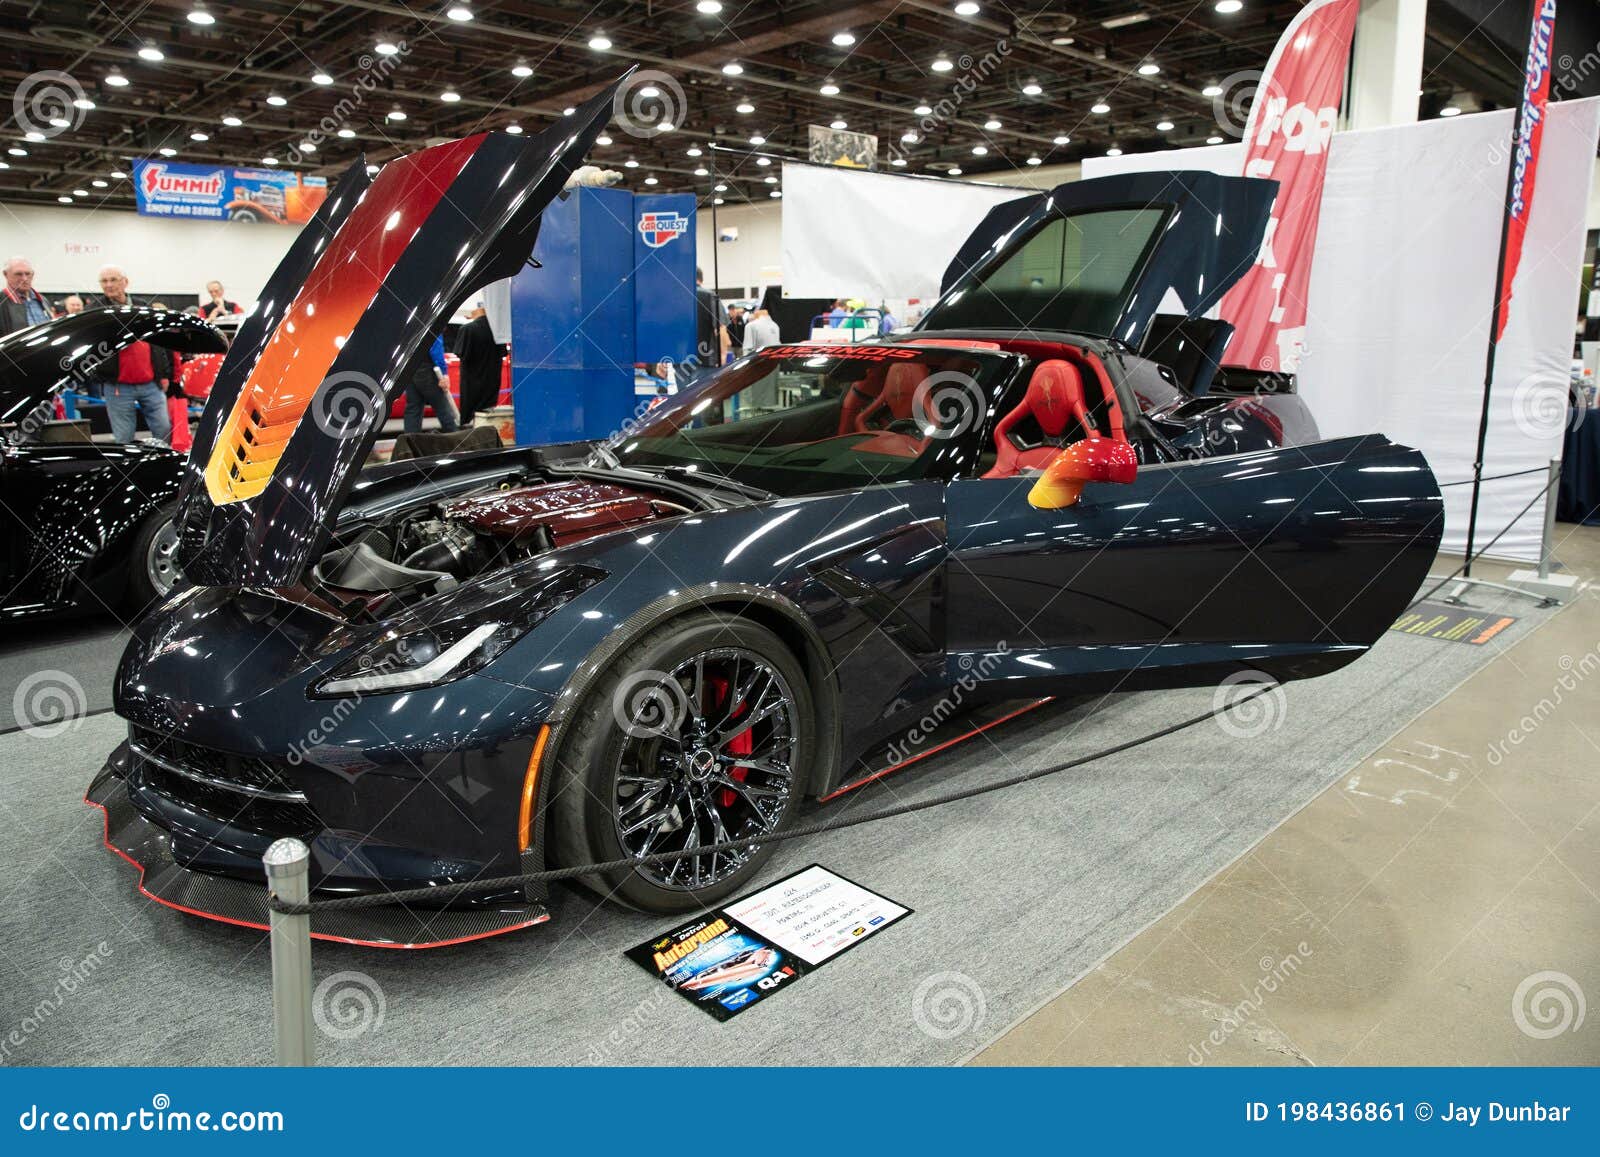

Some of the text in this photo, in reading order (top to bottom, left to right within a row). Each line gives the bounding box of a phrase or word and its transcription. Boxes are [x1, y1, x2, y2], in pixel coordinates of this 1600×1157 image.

[146, 203, 223, 217] SHOW CAR SERIES
[640, 220, 687, 231] CARQUEST
[679, 921, 707, 940] Detroit
[652, 918, 730, 973] Autorama
